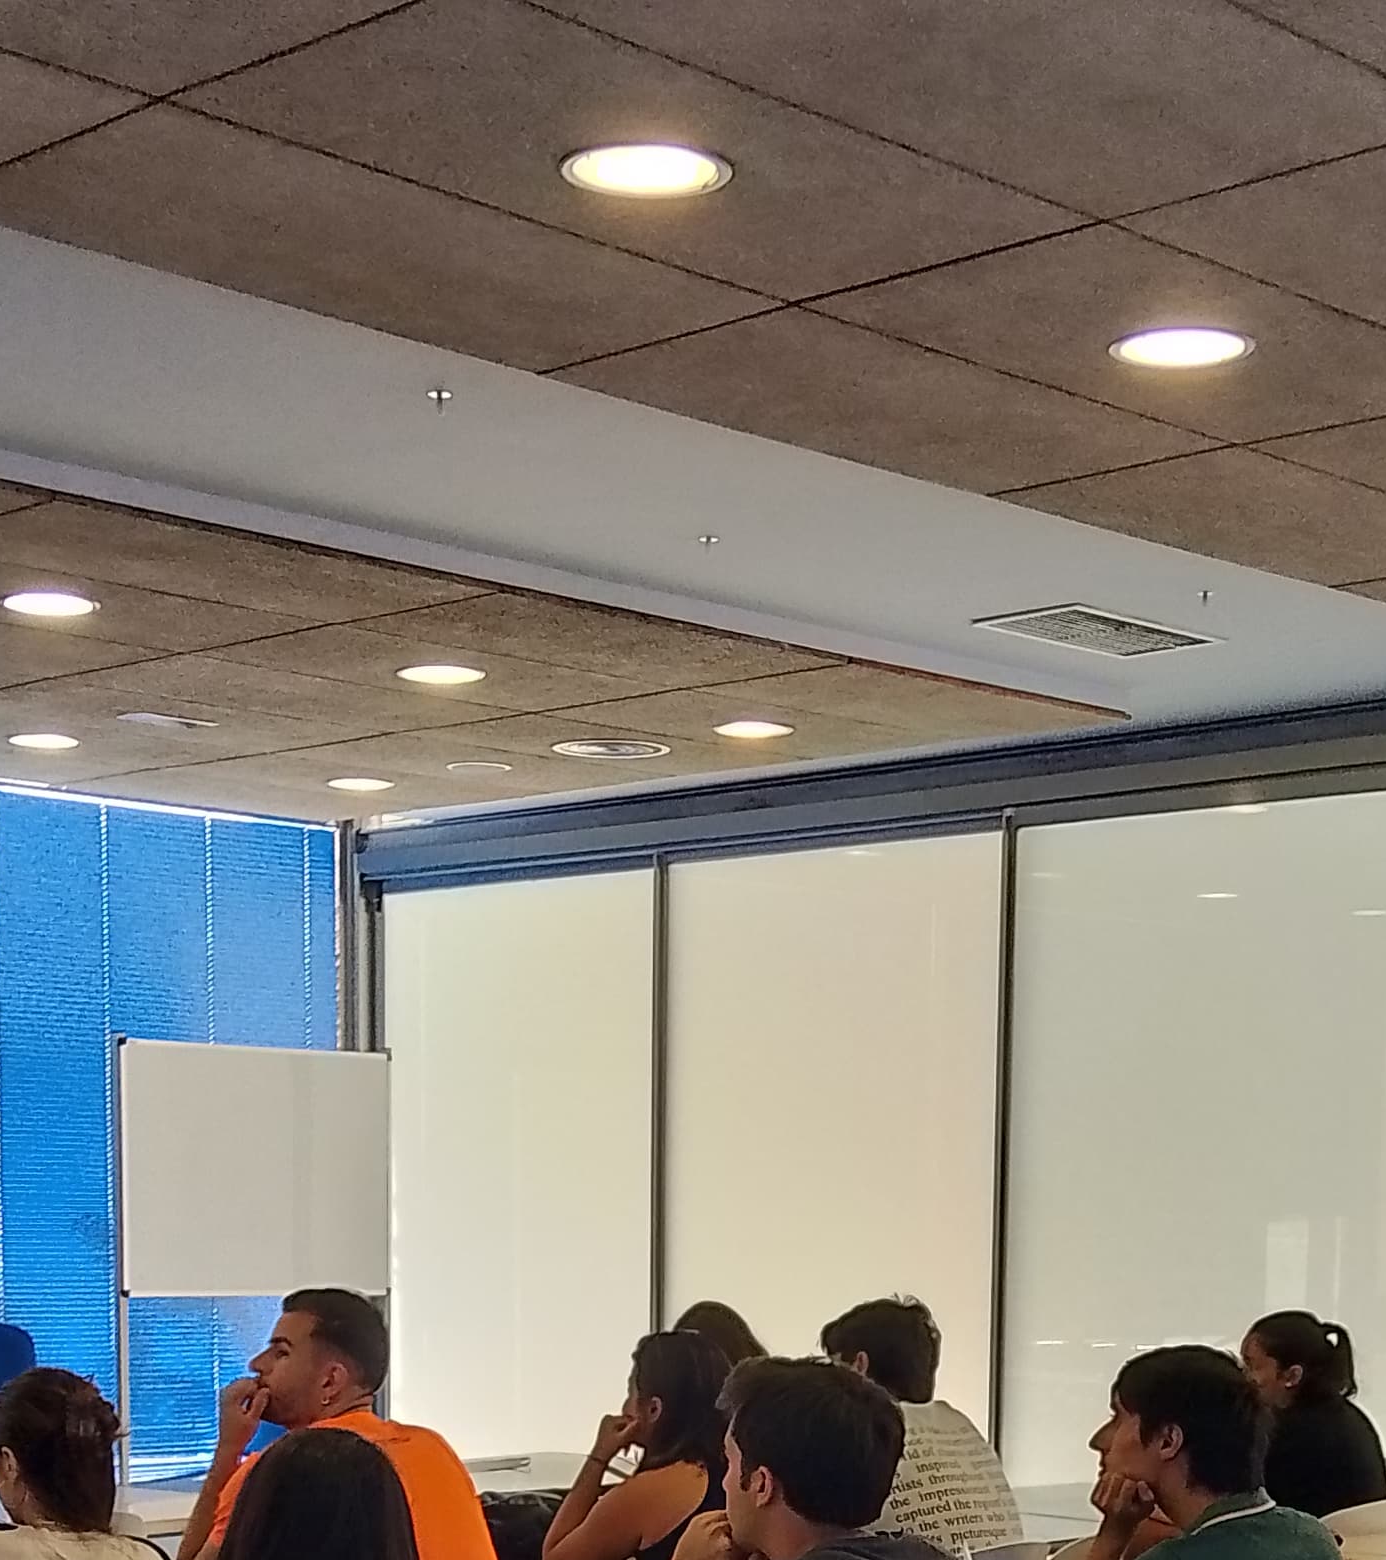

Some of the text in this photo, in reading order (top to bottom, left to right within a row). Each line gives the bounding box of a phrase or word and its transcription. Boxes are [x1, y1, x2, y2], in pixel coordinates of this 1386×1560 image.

[895, 1501, 952, 1523] captured
[954, 1500, 971, 1511] the
[919, 1519, 940, 1532] the
